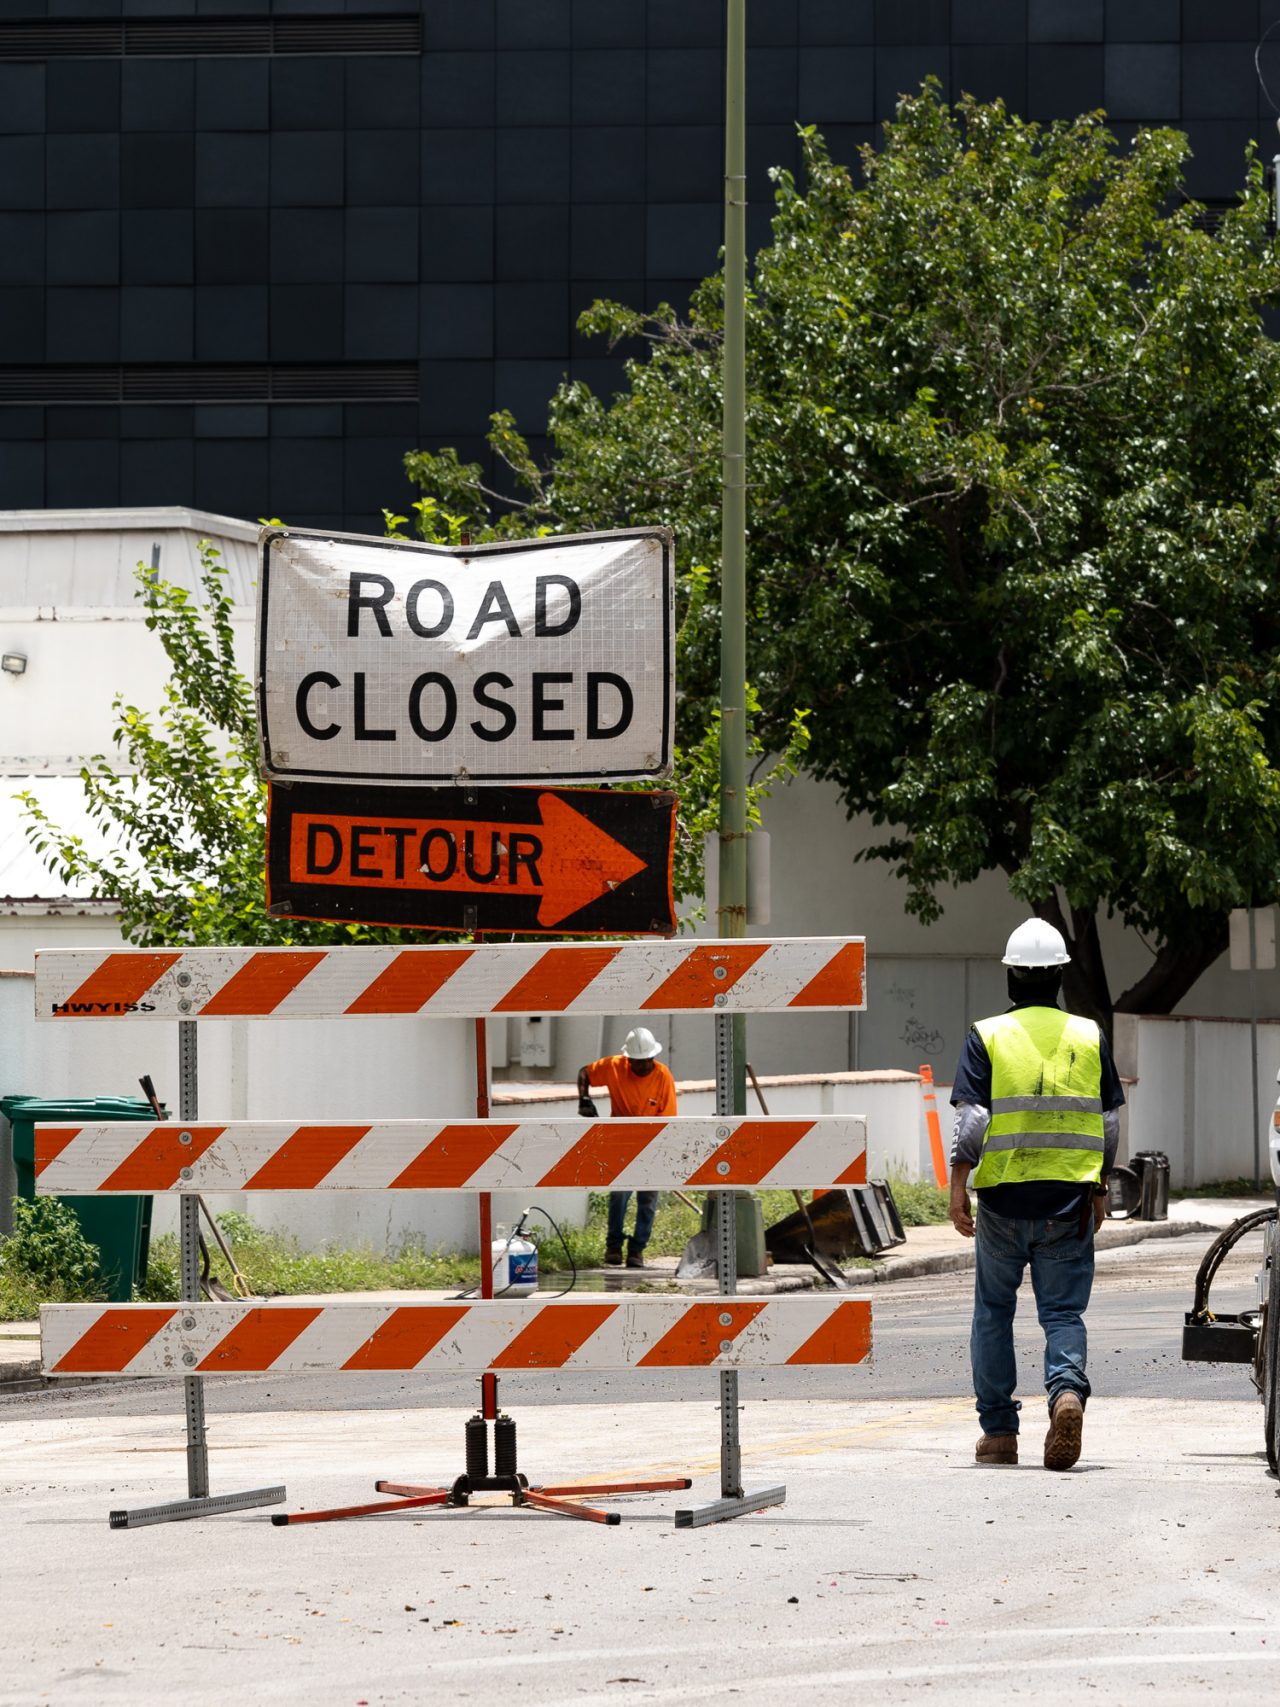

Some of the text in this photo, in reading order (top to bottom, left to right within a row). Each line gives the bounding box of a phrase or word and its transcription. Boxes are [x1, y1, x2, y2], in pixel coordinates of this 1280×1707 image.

[347, 571, 582, 640] ROAD
[295, 671, 634, 742] CLOSED
[306, 823, 544, 887] DETOUR
[51, 1002, 156, 1013] HWYISS
